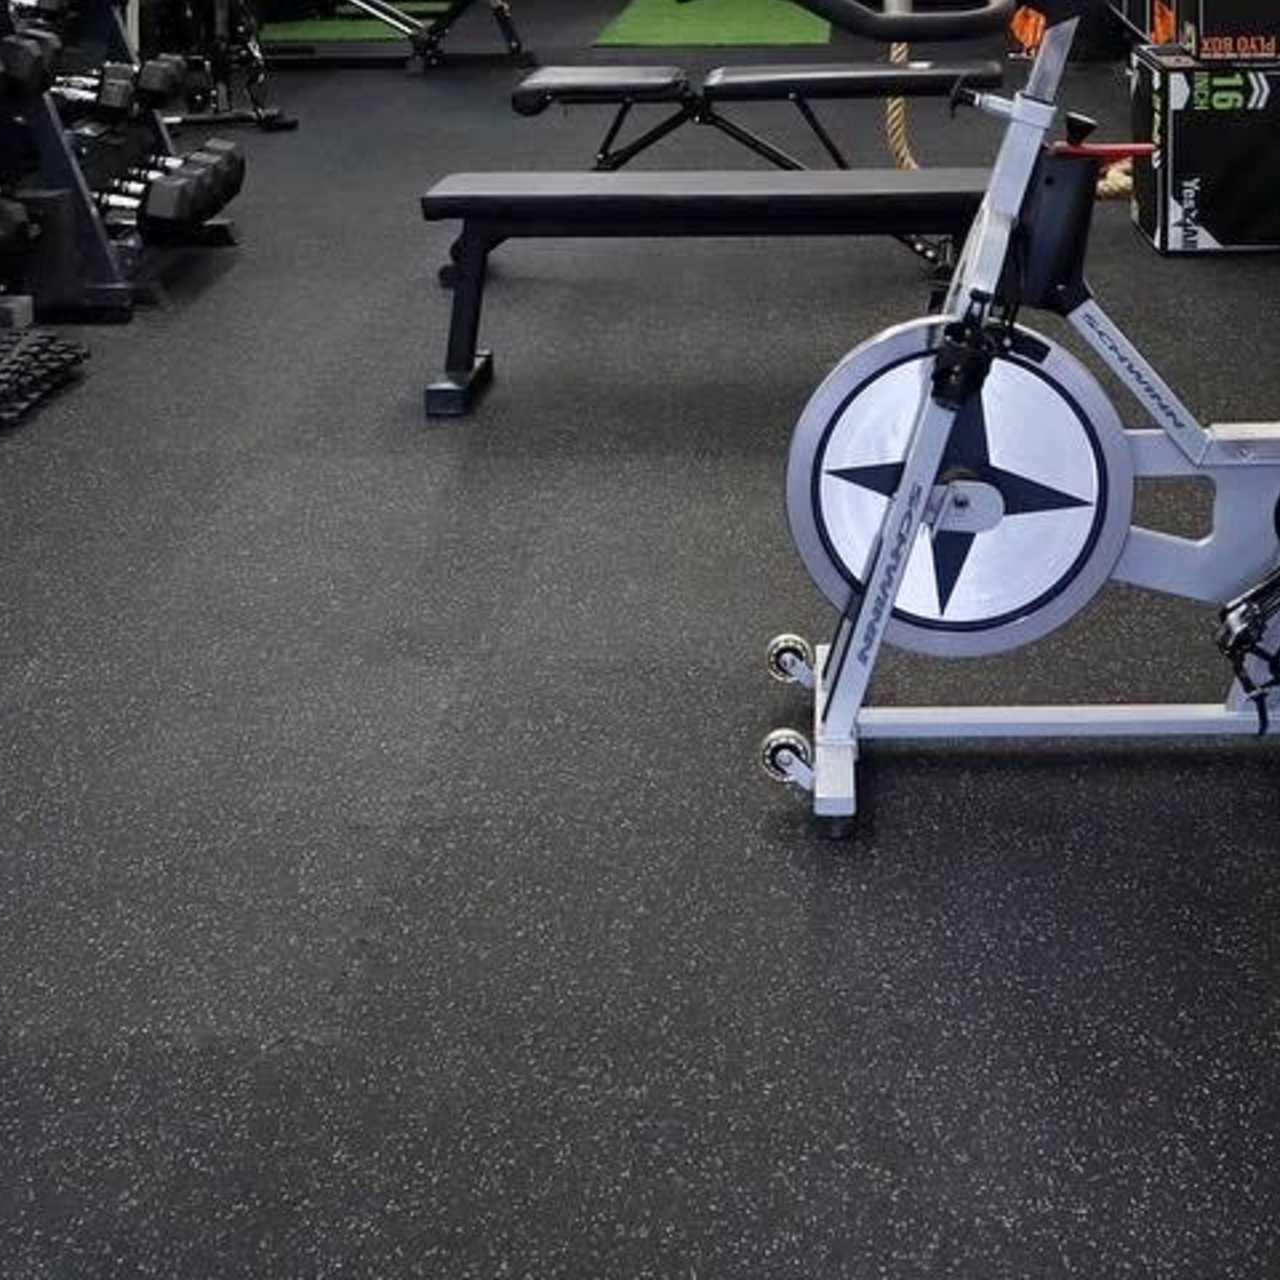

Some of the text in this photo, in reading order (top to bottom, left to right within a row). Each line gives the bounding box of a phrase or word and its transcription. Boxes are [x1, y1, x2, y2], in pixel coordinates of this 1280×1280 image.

[1200, 35, 1233, 52] BOX
[1236, 35, 1276, 52] PLYO
[1194, 72, 1210, 111] INCH
[1212, 72, 1244, 111] 16
[1081, 311, 1187, 428] SCHWINN
